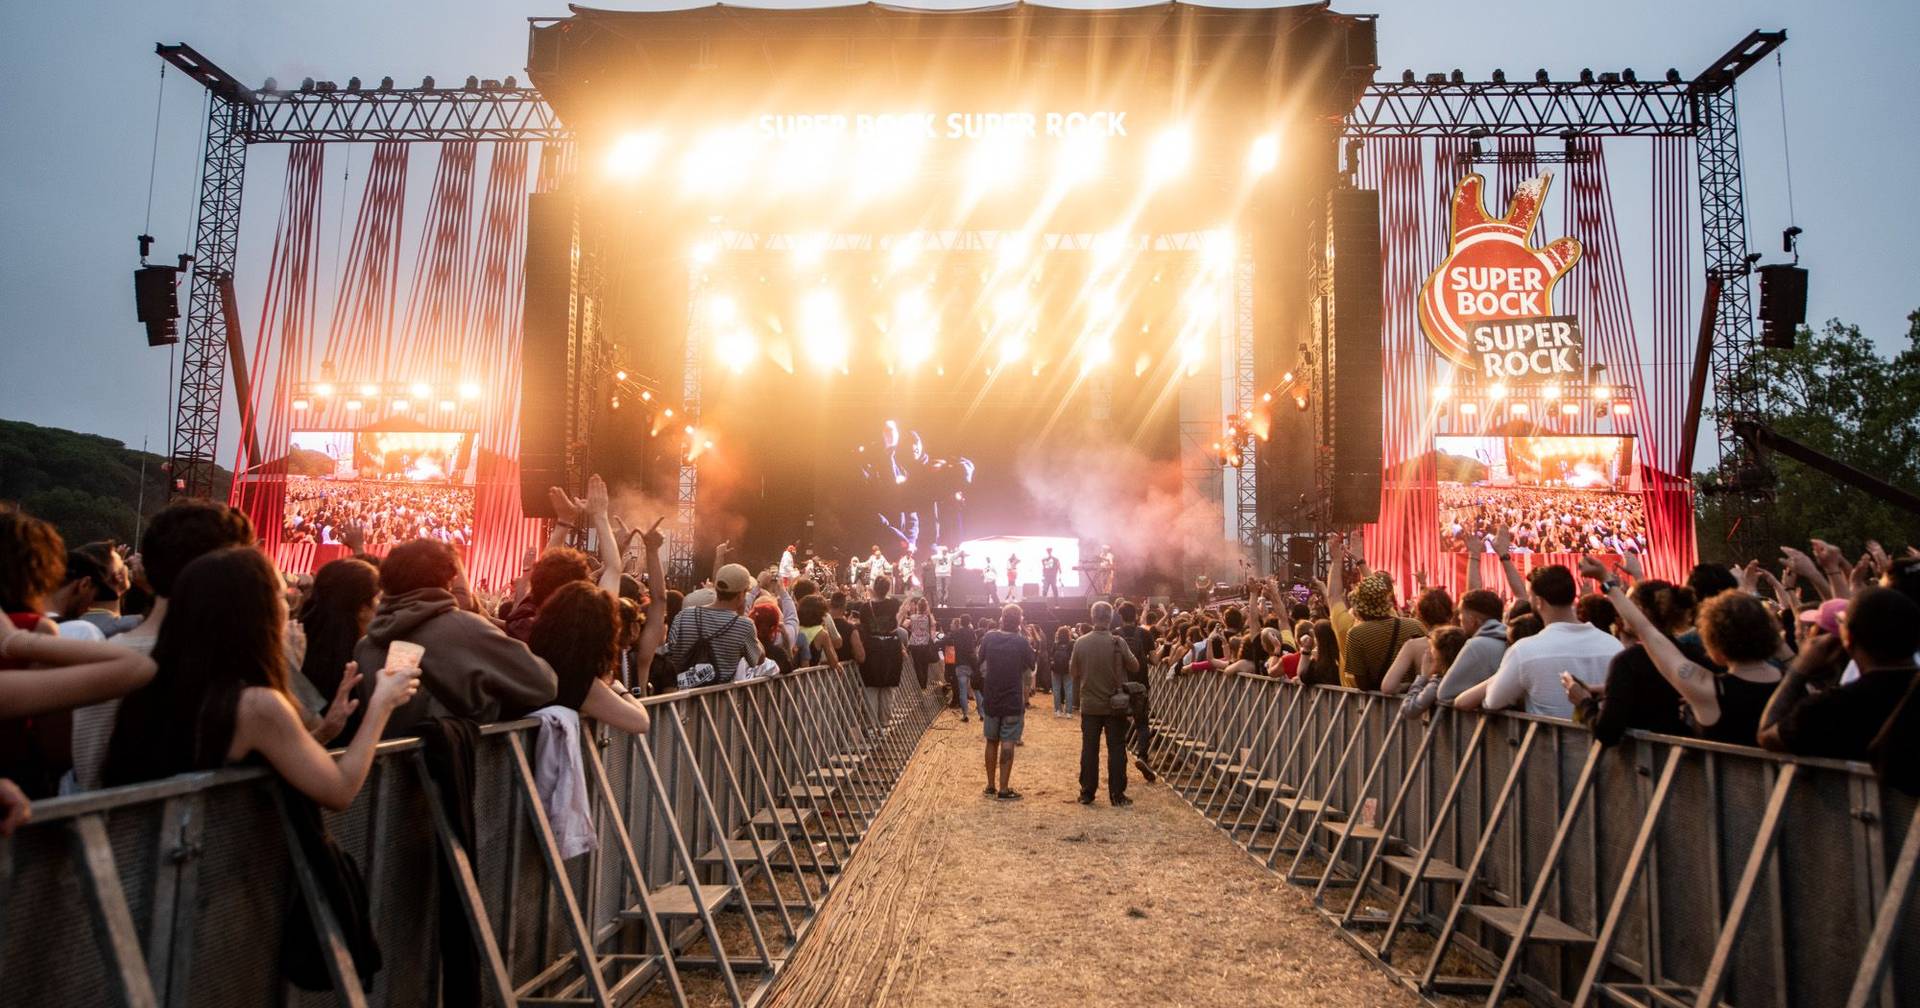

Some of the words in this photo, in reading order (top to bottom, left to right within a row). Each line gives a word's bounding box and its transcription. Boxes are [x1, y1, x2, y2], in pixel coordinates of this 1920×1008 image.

[946, 113, 1037, 139] SUPER
[1046, 112, 1128, 138] ROCK
[1451, 267, 1543, 291] SUPER
[1457, 292, 1540, 315] BOCK
[1474, 322, 1575, 351] SUPER
[1483, 348, 1575, 378] ROCK
